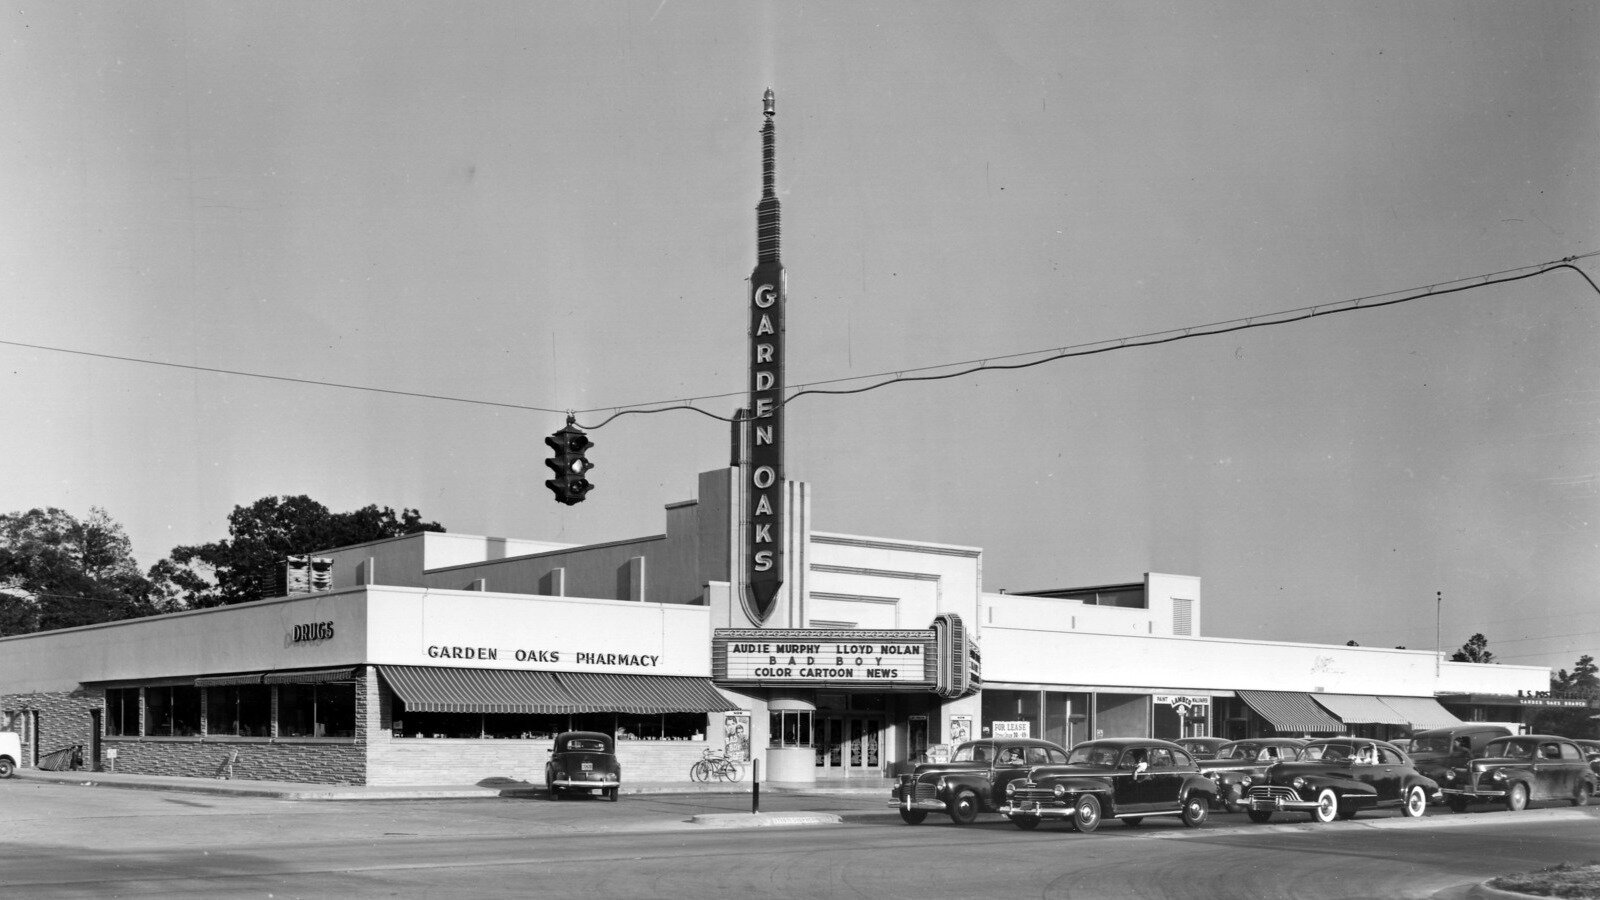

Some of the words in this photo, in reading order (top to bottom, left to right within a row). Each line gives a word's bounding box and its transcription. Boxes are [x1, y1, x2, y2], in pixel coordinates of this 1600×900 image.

[754, 283, 777, 446] GARDEN
[753, 465, 776, 572] OAKS
[292, 620, 334, 642] DRUGS
[428, 645, 498, 660] GARDEN
[514, 649, 560, 663] OAKS
[576, 652, 659, 667] PHARMACY
[733, 643, 770, 654] AUDIE
[776, 643, 821, 655] MURPHY
[836, 644, 873, 655] LLOYD
[880, 644, 920, 656] NOLAN
[769, 655, 816, 666] BAD
[836, 656, 882, 667] BOY
[754, 667, 792, 678] COLOR
[799, 667, 854, 679] CARTOON
[866, 668, 898, 679] NEWS
[994, 723, 1006, 731] FOR
[1007, 723, 1027, 731] LEASE
